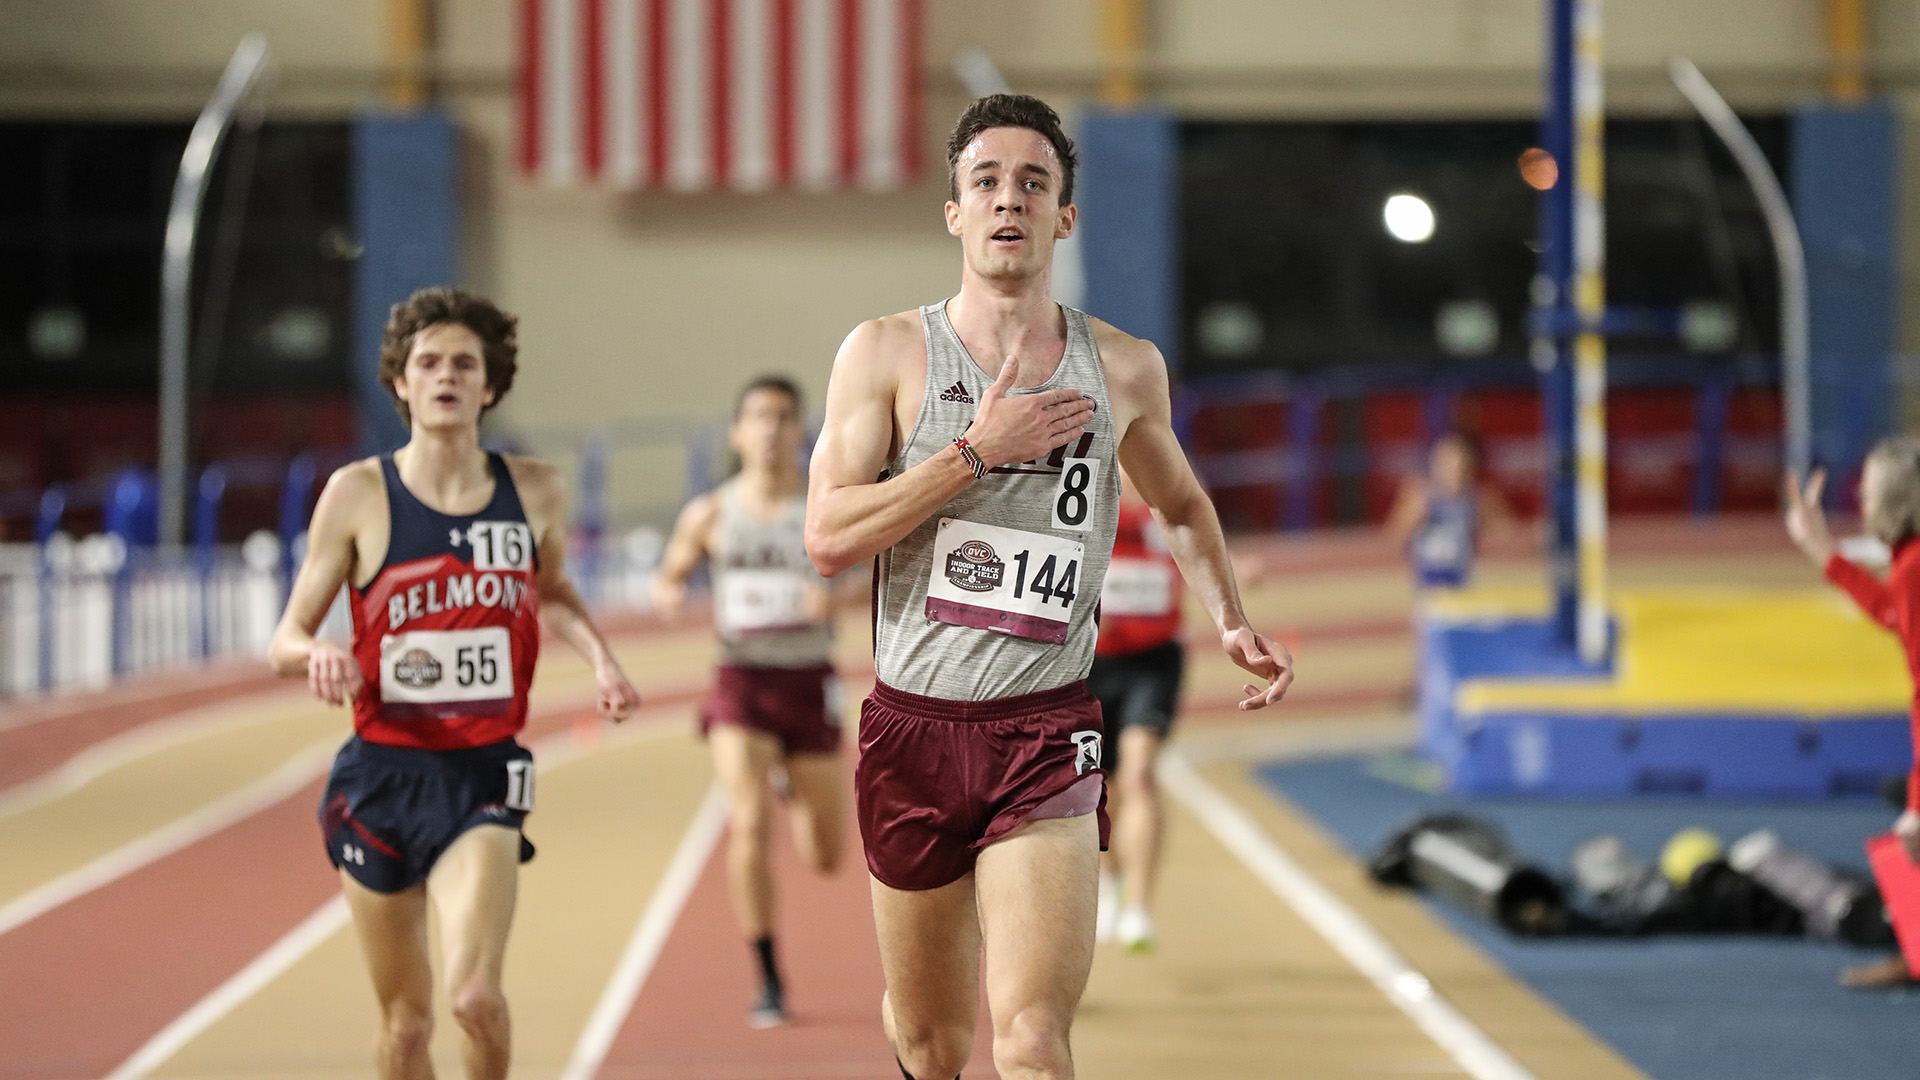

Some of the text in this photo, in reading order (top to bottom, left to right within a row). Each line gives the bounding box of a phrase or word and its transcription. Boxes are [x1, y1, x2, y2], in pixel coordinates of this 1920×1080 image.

[940, 392, 974, 404] adidas
[1057, 463, 1090, 526] 8
[477, 527, 522, 566] 16
[968, 548, 986, 557] OVC
[951, 560, 999, 573] INDOOR TRACK
[951, 566, 999, 579] AND FIELD
[1013, 550, 1077, 608] 144
[456, 646, 497, 686] 55
